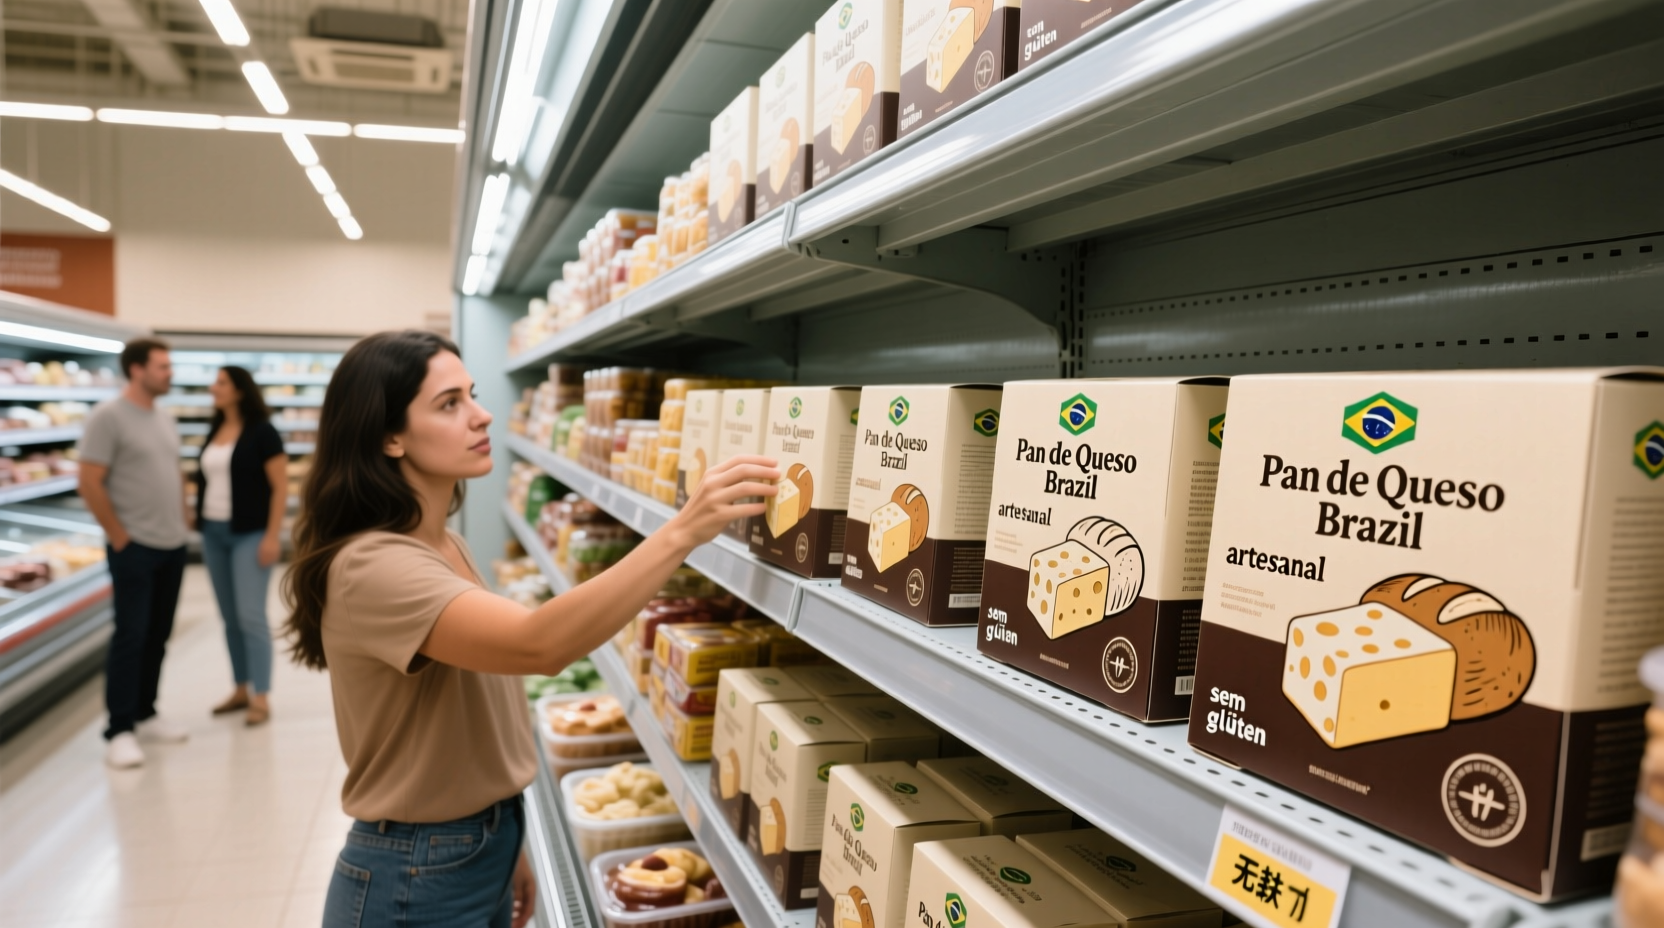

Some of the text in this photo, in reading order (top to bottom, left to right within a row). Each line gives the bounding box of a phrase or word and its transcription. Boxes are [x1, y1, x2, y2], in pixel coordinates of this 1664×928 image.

[881, 430, 893, 448] de
[1016, 438, 1137, 474] Pan de Queso
[1044, 470, 1098, 500] Brazil
[1260, 453, 1506, 512] Pan de Queso
[1314, 501, 1424, 550] Brazil
[1225, 545, 1326, 582] artesanal
[1209, 686, 1246, 712] sem
[1205, 708, 1266, 747] glüten
